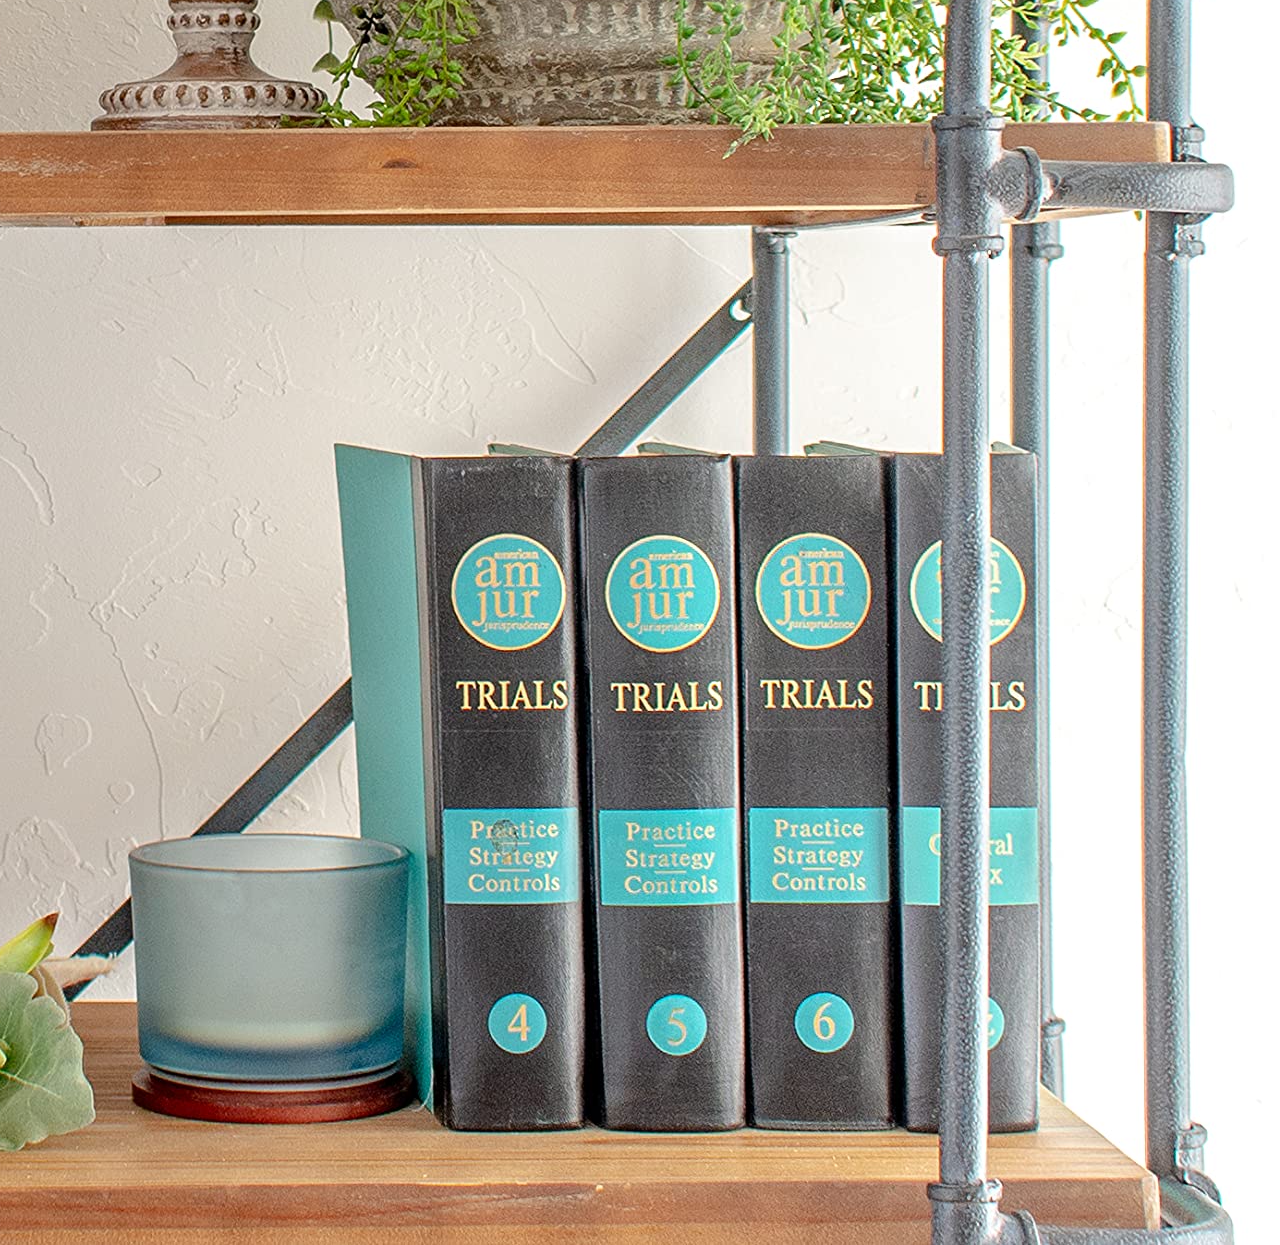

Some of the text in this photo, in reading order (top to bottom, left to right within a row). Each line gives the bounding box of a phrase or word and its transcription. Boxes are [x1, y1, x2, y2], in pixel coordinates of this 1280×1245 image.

[475, 556, 542, 588] am
[629, 557, 696, 589] am
[780, 555, 846, 587] am
[472, 589, 540, 626] jur
[627, 591, 694, 629] jur
[775, 588, 844, 626] jur
[456, 680, 569, 711] TRIALS
[611, 681, 723, 712] TRIALS
[760, 679, 874, 710] TRIALS
[913, 680, 1027, 711] TLS
[469, 819, 559, 840] Prctice
[625, 821, 716, 841] Practice
[773, 818, 865, 838] Practice
[625, 848, 716, 870] Strategy
[773, 845, 864, 868] Strategy
[468, 873, 561, 893] Controls
[624, 874, 719, 895] Controls
[771, 872, 867, 891] Controls
[507, 1003, 531, 1042] 4
[666, 1008, 688, 1047] 5
[812, 1001, 836, 1040] 6
